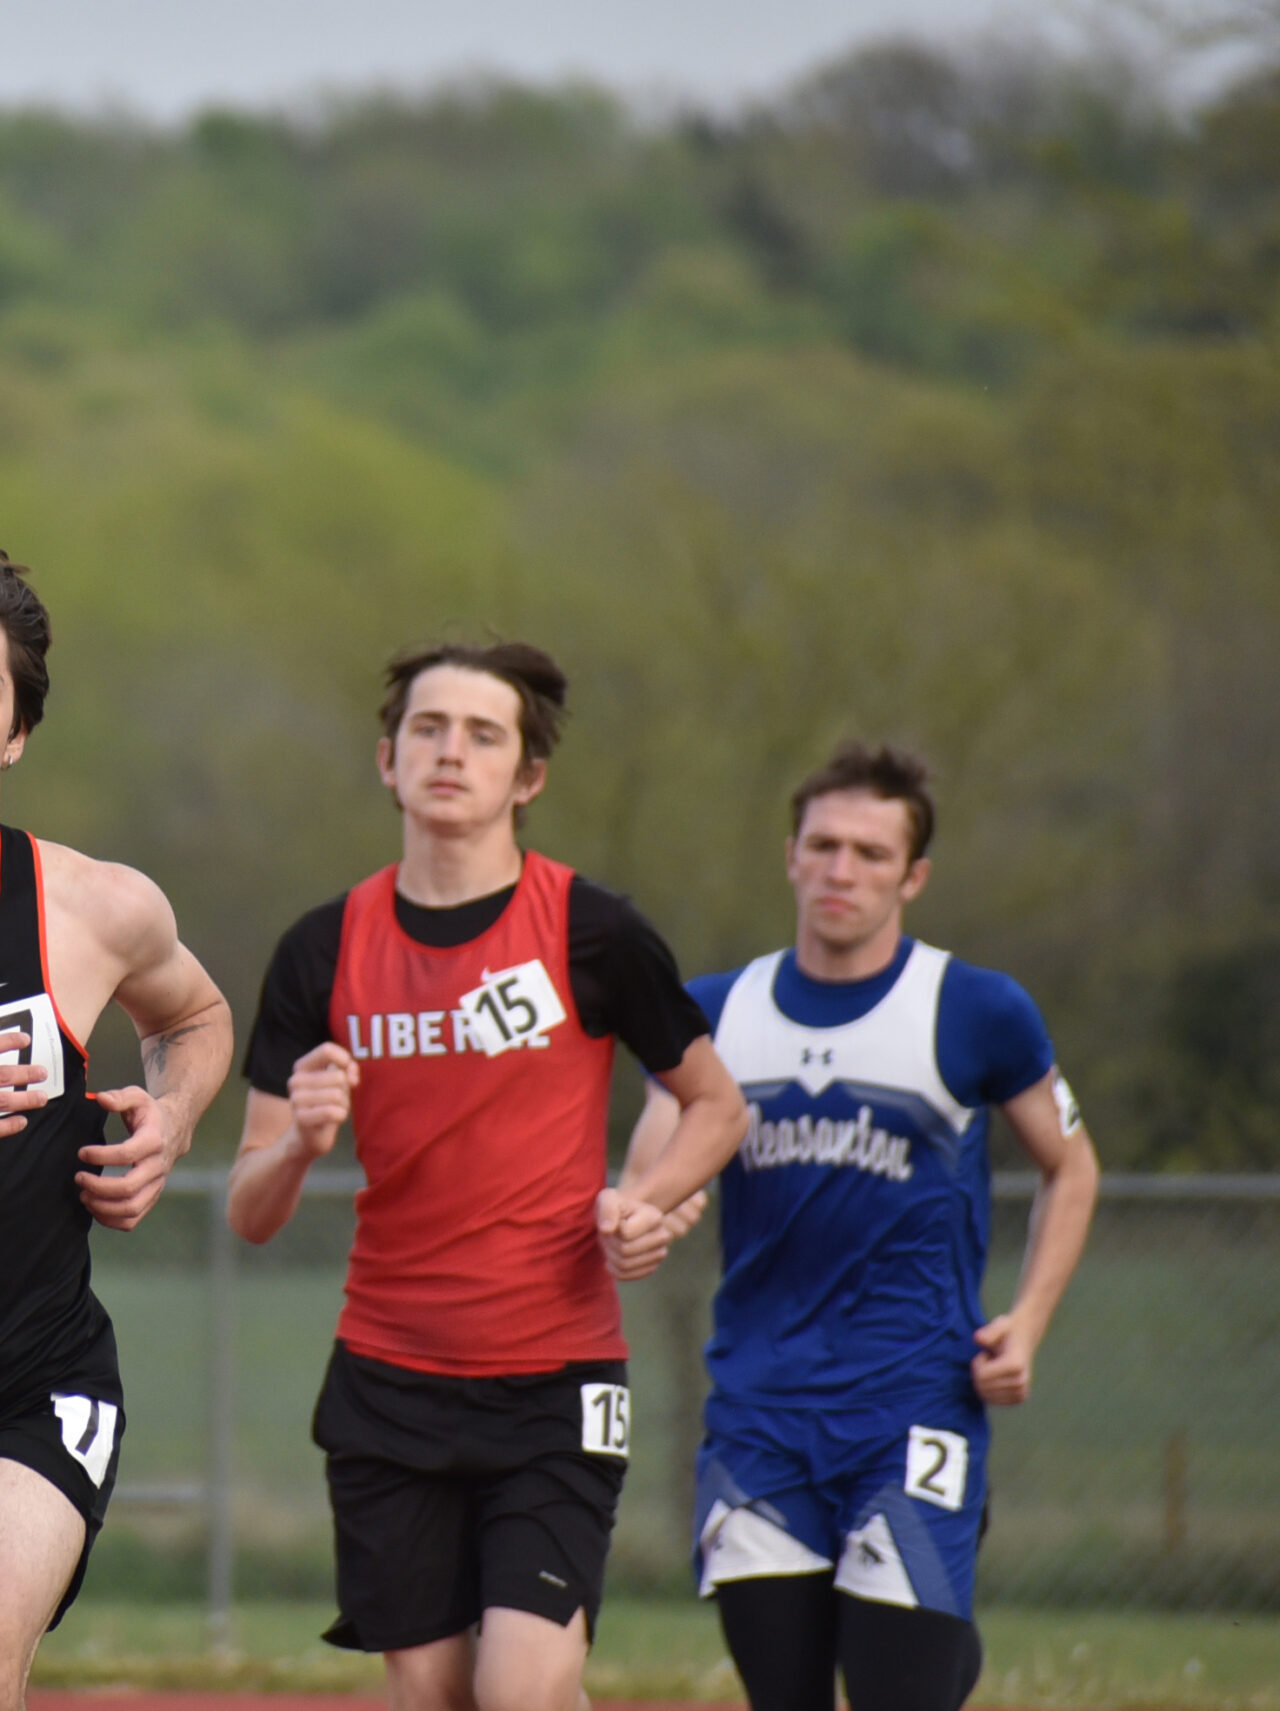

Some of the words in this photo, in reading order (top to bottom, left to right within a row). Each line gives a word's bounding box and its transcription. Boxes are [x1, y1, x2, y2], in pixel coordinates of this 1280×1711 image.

[346, 1008, 551, 1059] LIBER
[474, 975, 538, 1043] 15
[591, 1389, 626, 1450] 15
[915, 1437, 948, 1496] 2
